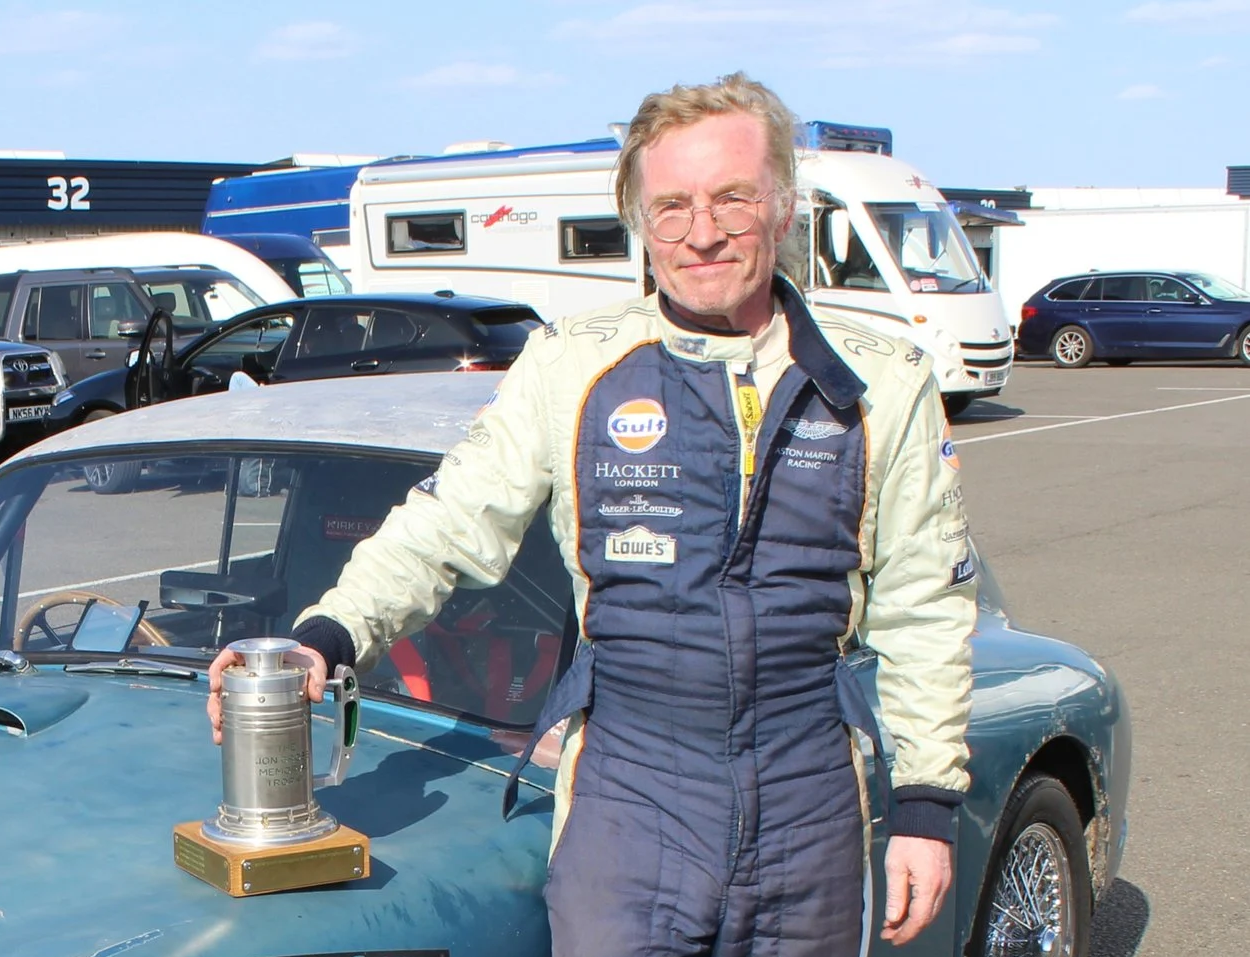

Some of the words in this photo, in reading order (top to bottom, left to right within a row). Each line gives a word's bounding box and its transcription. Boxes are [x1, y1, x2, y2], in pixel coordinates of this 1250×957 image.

[47, 176, 90, 210] 32
[12, 407, 33, 420] NK56
[611, 417, 667, 434] Gulf
[775, 446, 804, 458] ASTON
[804, 450, 837, 461] MARTIN
[595, 462, 681, 479] HACKETT
[787, 458, 821, 470] RACING
[614, 480, 659, 488] LONDON
[612, 538, 666, 556] LOWE'S
